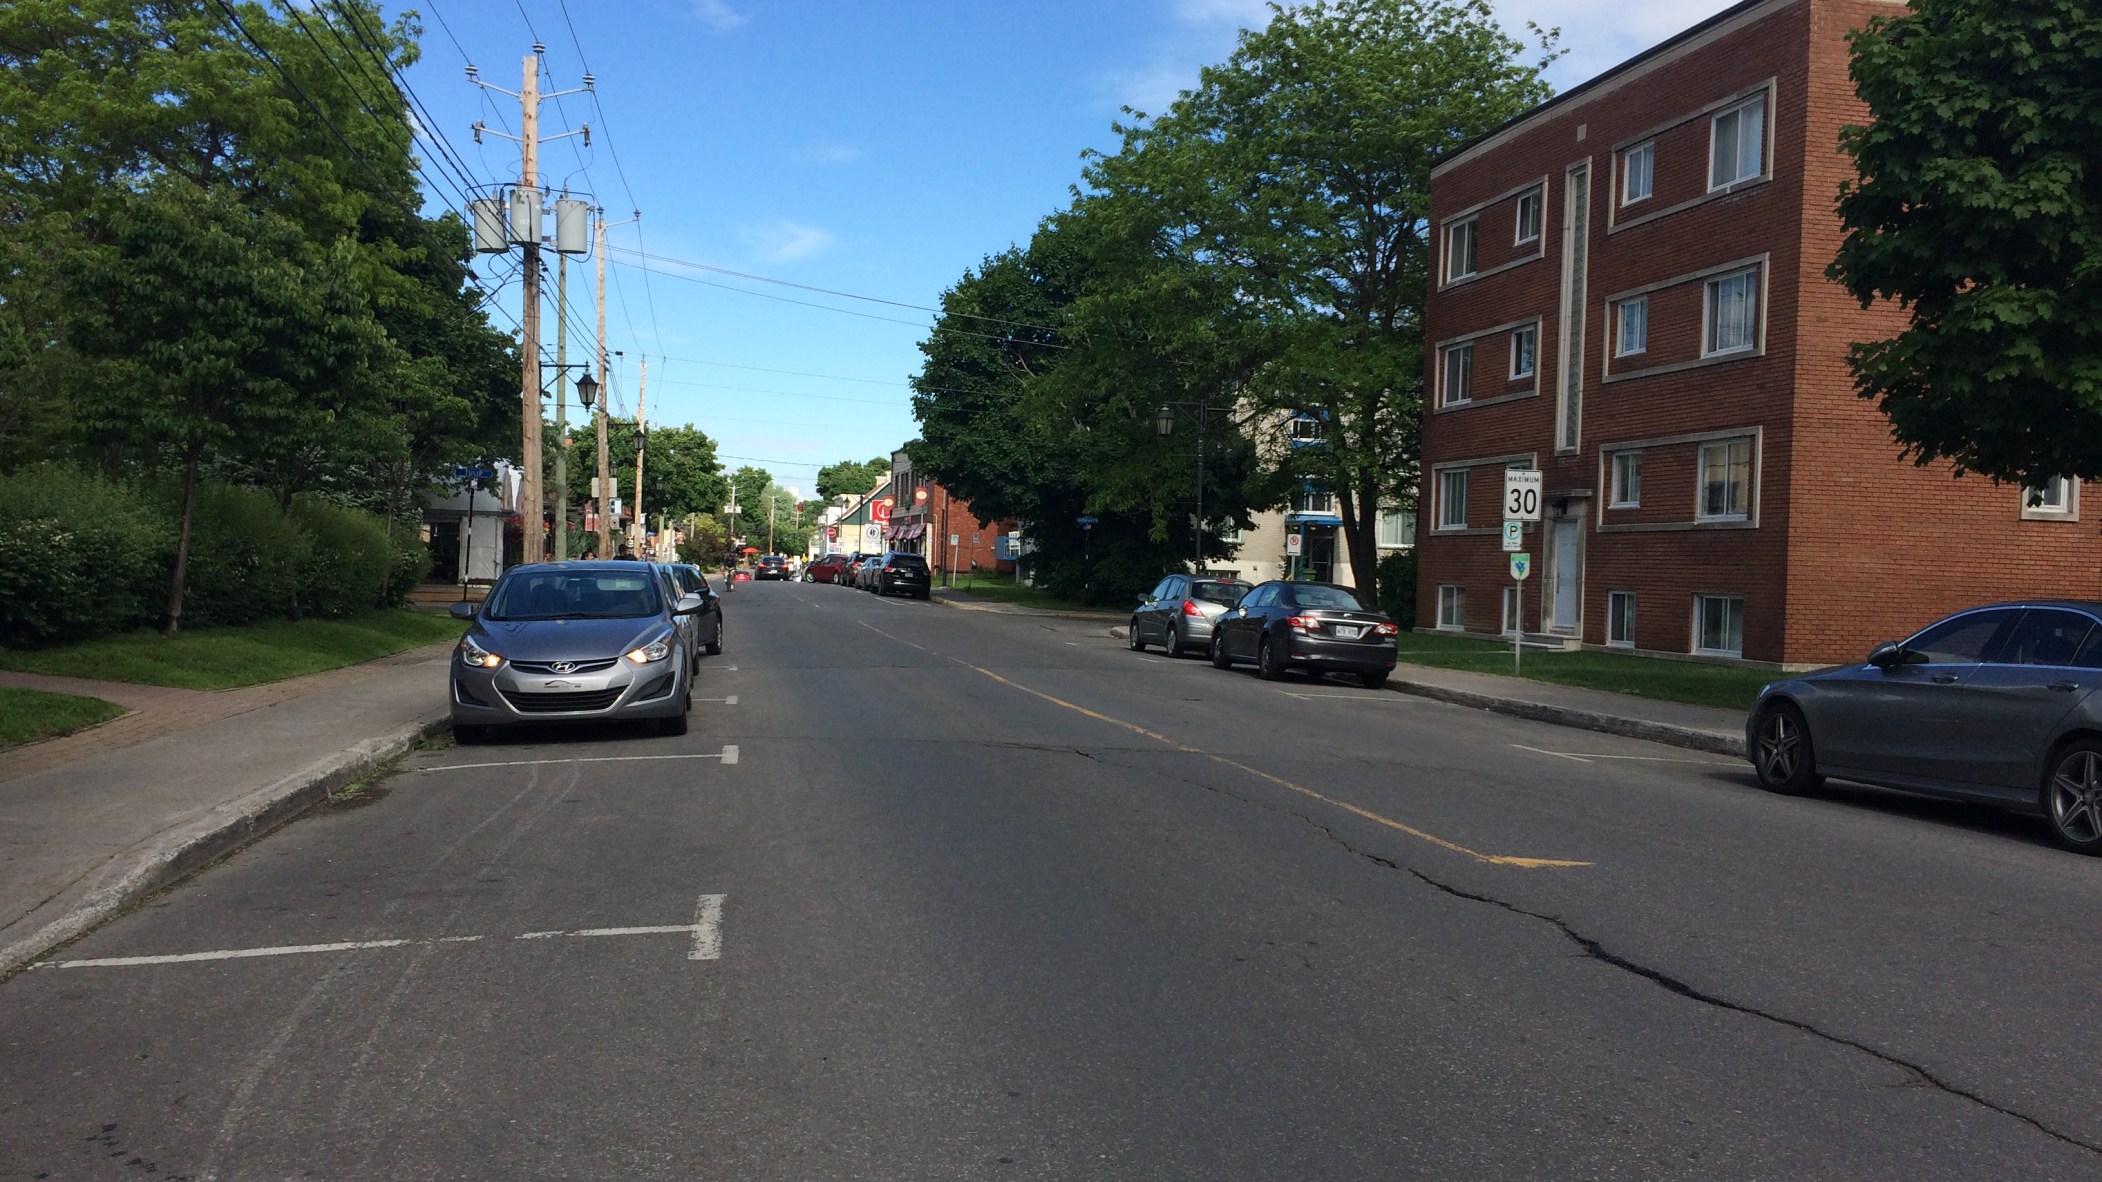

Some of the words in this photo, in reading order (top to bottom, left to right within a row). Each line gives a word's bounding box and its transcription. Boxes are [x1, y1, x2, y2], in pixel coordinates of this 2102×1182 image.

[465, 469, 484, 477] TULIP
[1509, 488, 1537, 514] 30
[1509, 525, 1518, 537] P
